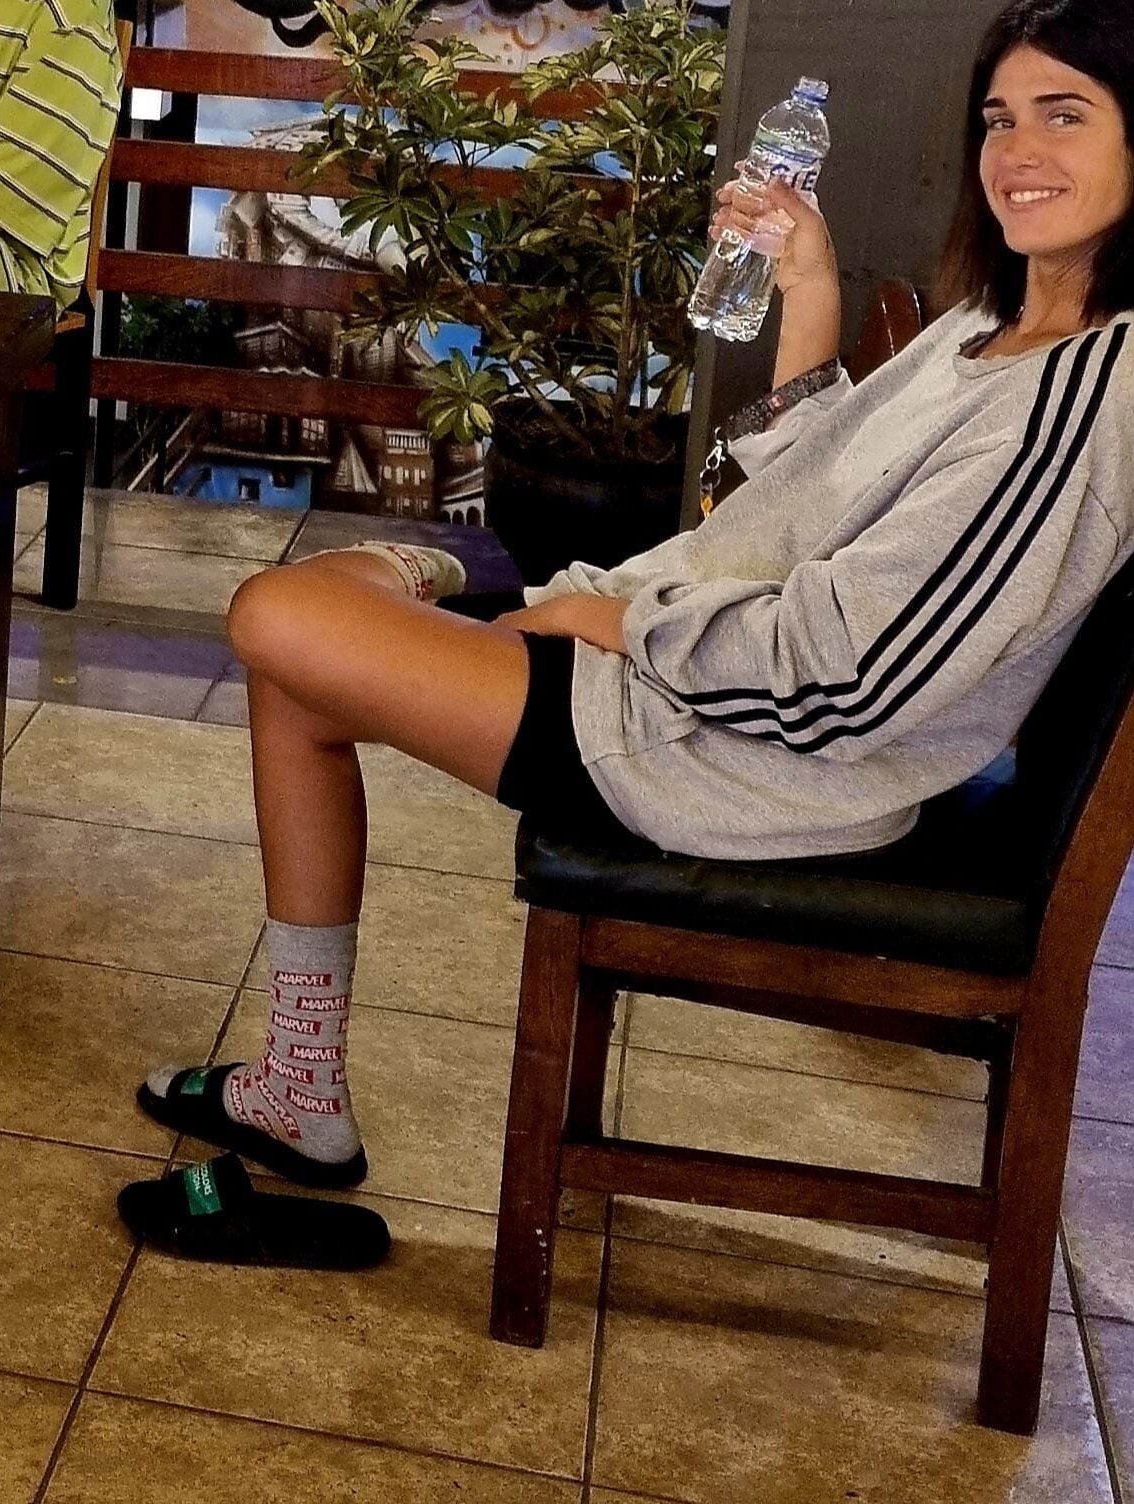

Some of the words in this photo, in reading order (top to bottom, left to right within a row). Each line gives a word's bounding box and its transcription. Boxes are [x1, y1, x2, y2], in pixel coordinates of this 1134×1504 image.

[277, 971, 326, 986] MARVEL
[273, 1012, 316, 1035] MARVEL
[293, 1045, 339, 1061] MARVEL
[267, 1053, 310, 1083] MARVEL
[257, 1080, 299, 1134] MARVEL
[290, 1089, 337, 1114] MARVEL
